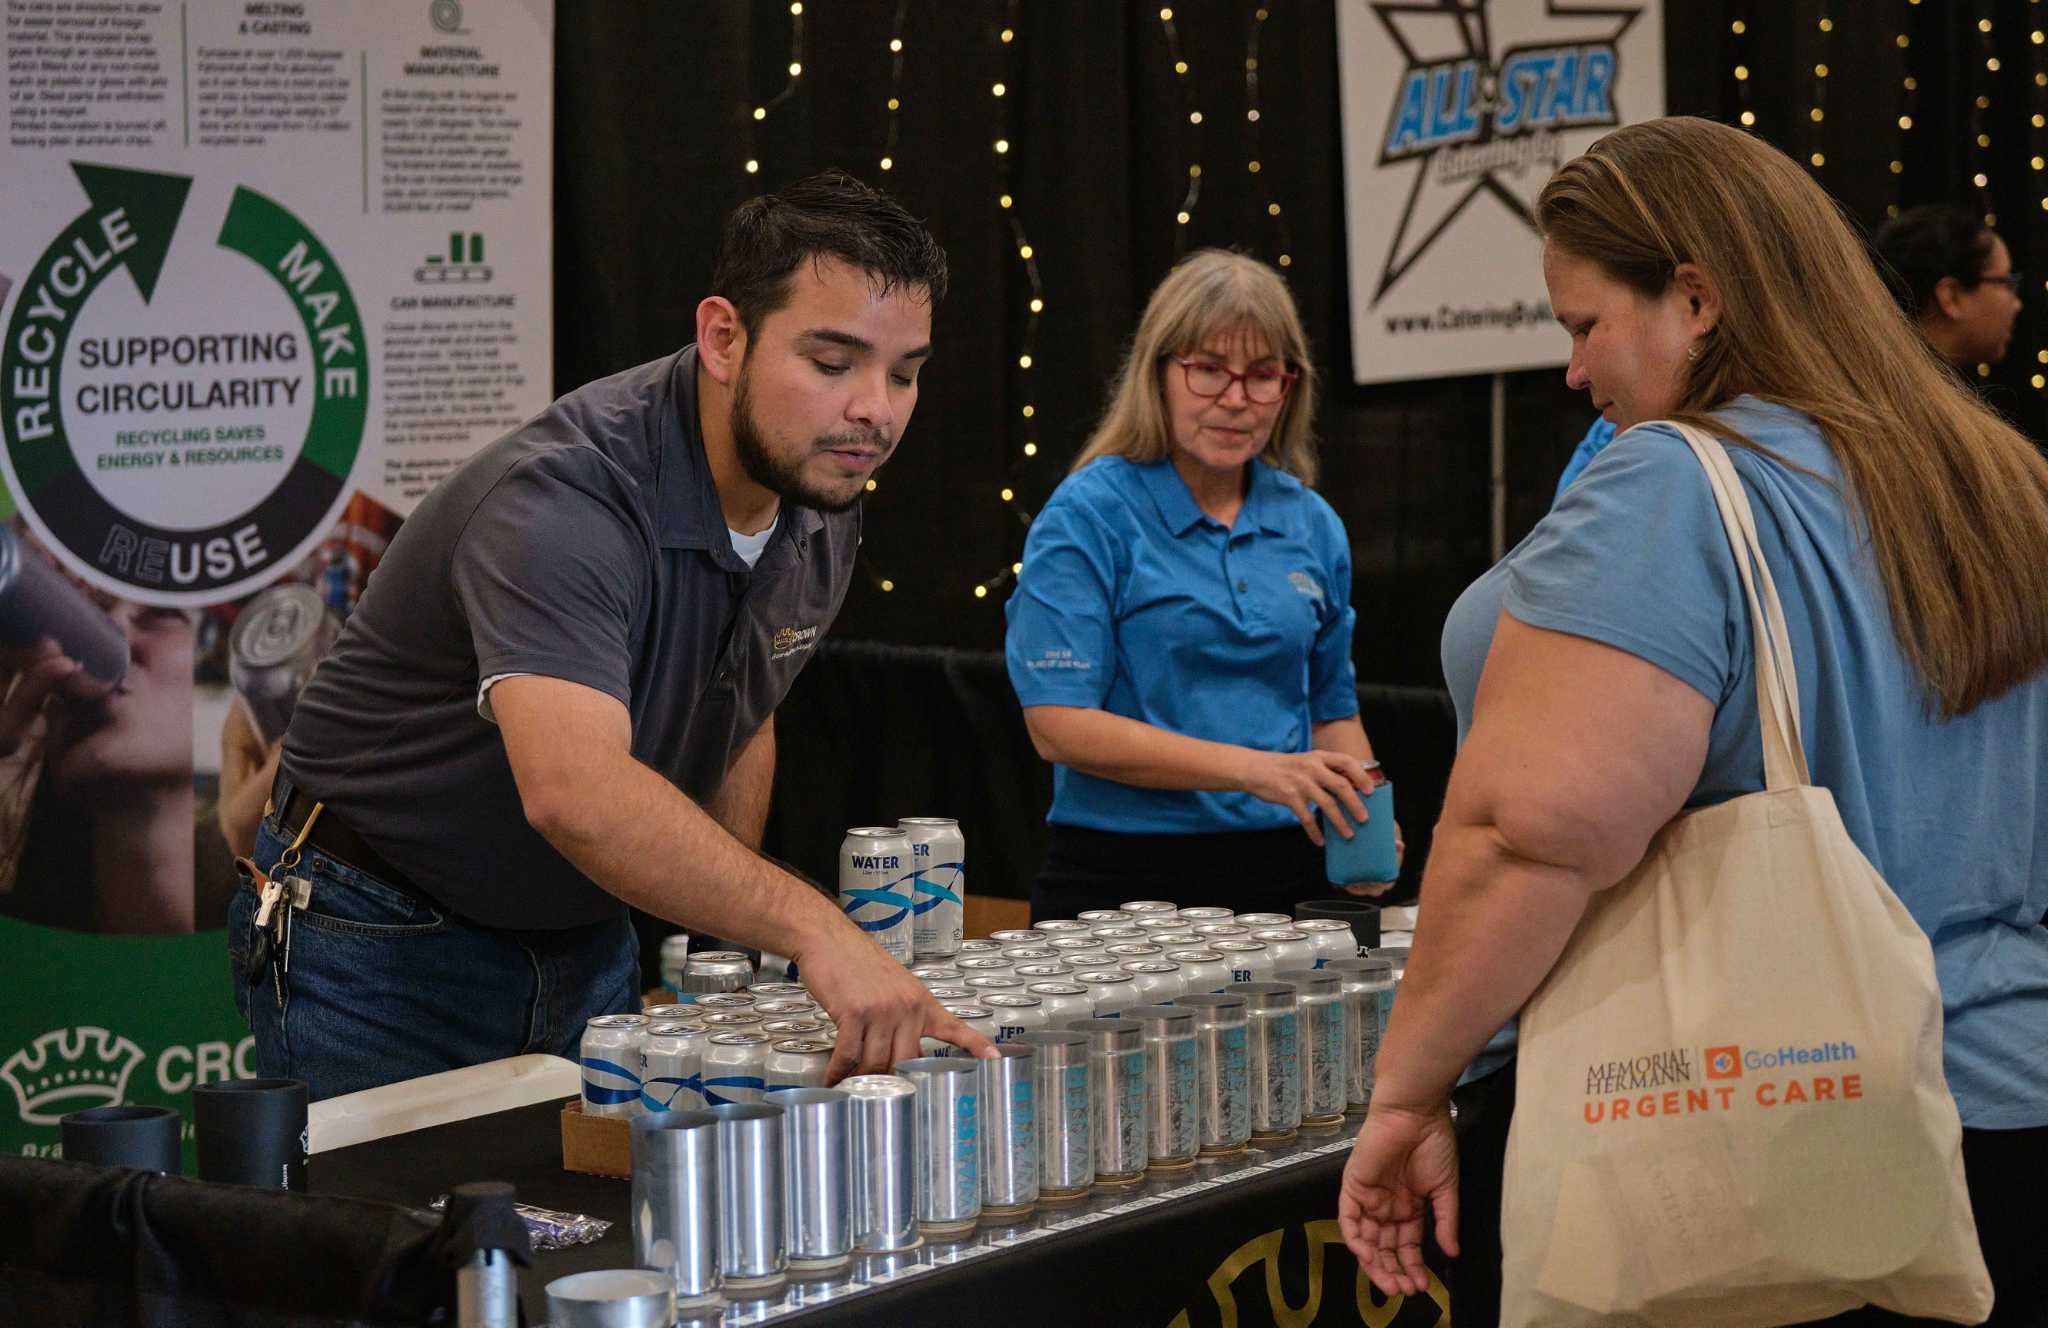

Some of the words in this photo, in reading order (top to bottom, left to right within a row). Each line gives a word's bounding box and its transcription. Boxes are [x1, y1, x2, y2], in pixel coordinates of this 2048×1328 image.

[1387, 64, 1478, 151] ALL
[1496, 49, 1613, 132] STAR
[15, 207, 138, 441] RECYCLE
[279, 240, 357, 400] MAKE
[80, 333, 297, 368] SUPPORTING
[76, 376, 302, 415] CIRCULARITY
[116, 429, 211, 446] RECYCLING
[215, 425, 266, 442] SAVES
[97, 451, 165, 470] ENERGY
[169, 451, 181, 466] &
[185, 447, 284, 466] RESOURCES
[852, 855, 899, 869] WATER
[1232, 969, 1252, 982] ER
[1587, 1049, 1690, 1081] MEMORIAL
[1744, 1041, 1857, 1070] GoHealth
[1586, 1064, 1690, 1095] HERMANN
[1584, 1087, 1736, 1124] URGENT
[1755, 1074, 1864, 1107] CARE
